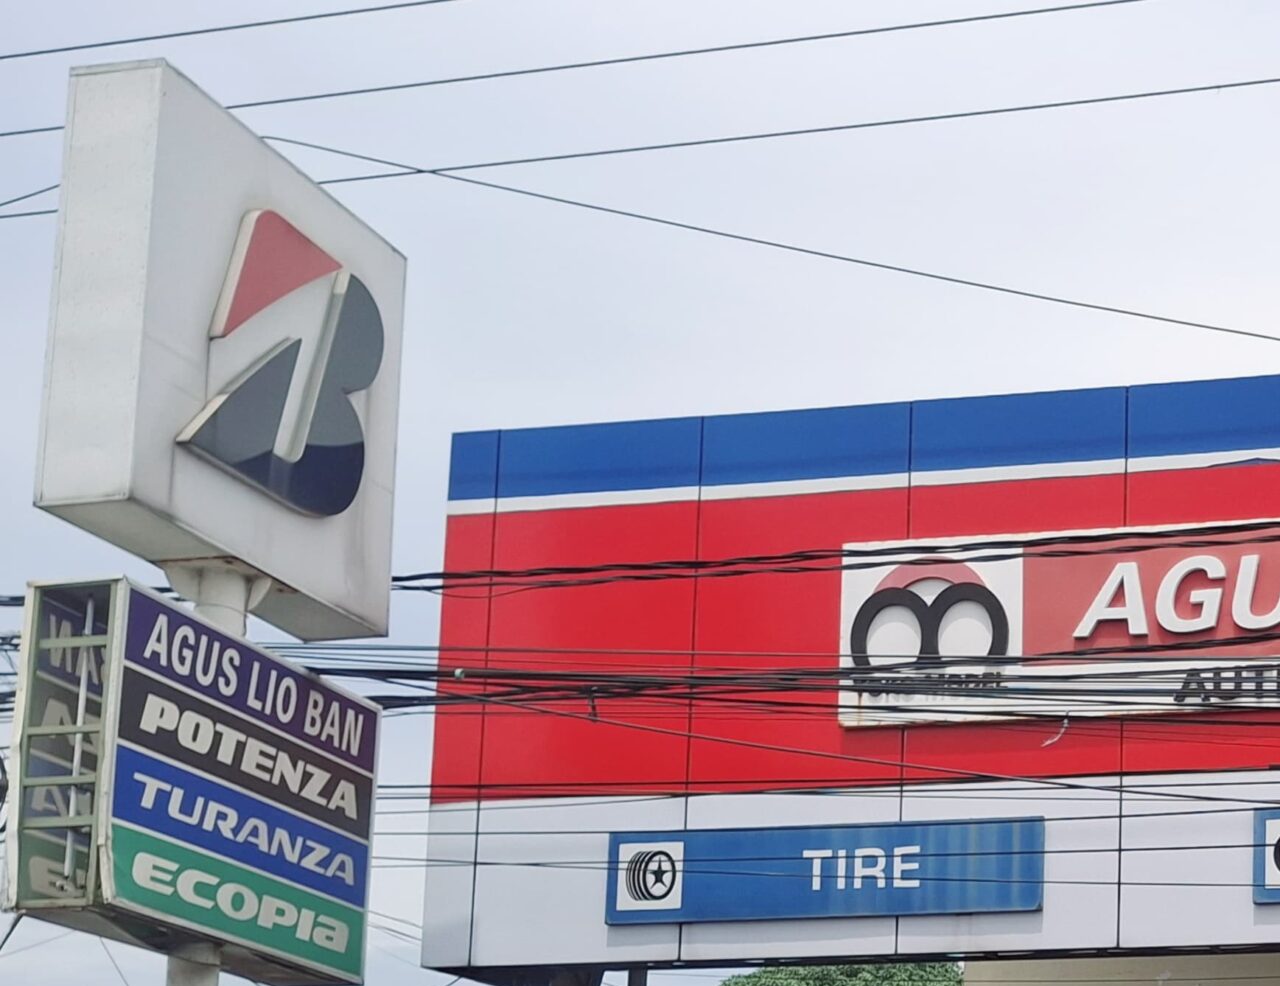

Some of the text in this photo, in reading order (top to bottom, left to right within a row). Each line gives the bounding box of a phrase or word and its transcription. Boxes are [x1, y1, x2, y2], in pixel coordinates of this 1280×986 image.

[143, 612, 240, 698] AGUS
[246, 659, 297, 724] LIO
[303, 689, 363, 757] BAN
[139, 693, 359, 820] POTENZA
[133, 772, 355, 886] TURANZA
[803, 845, 921, 891] TIRE
